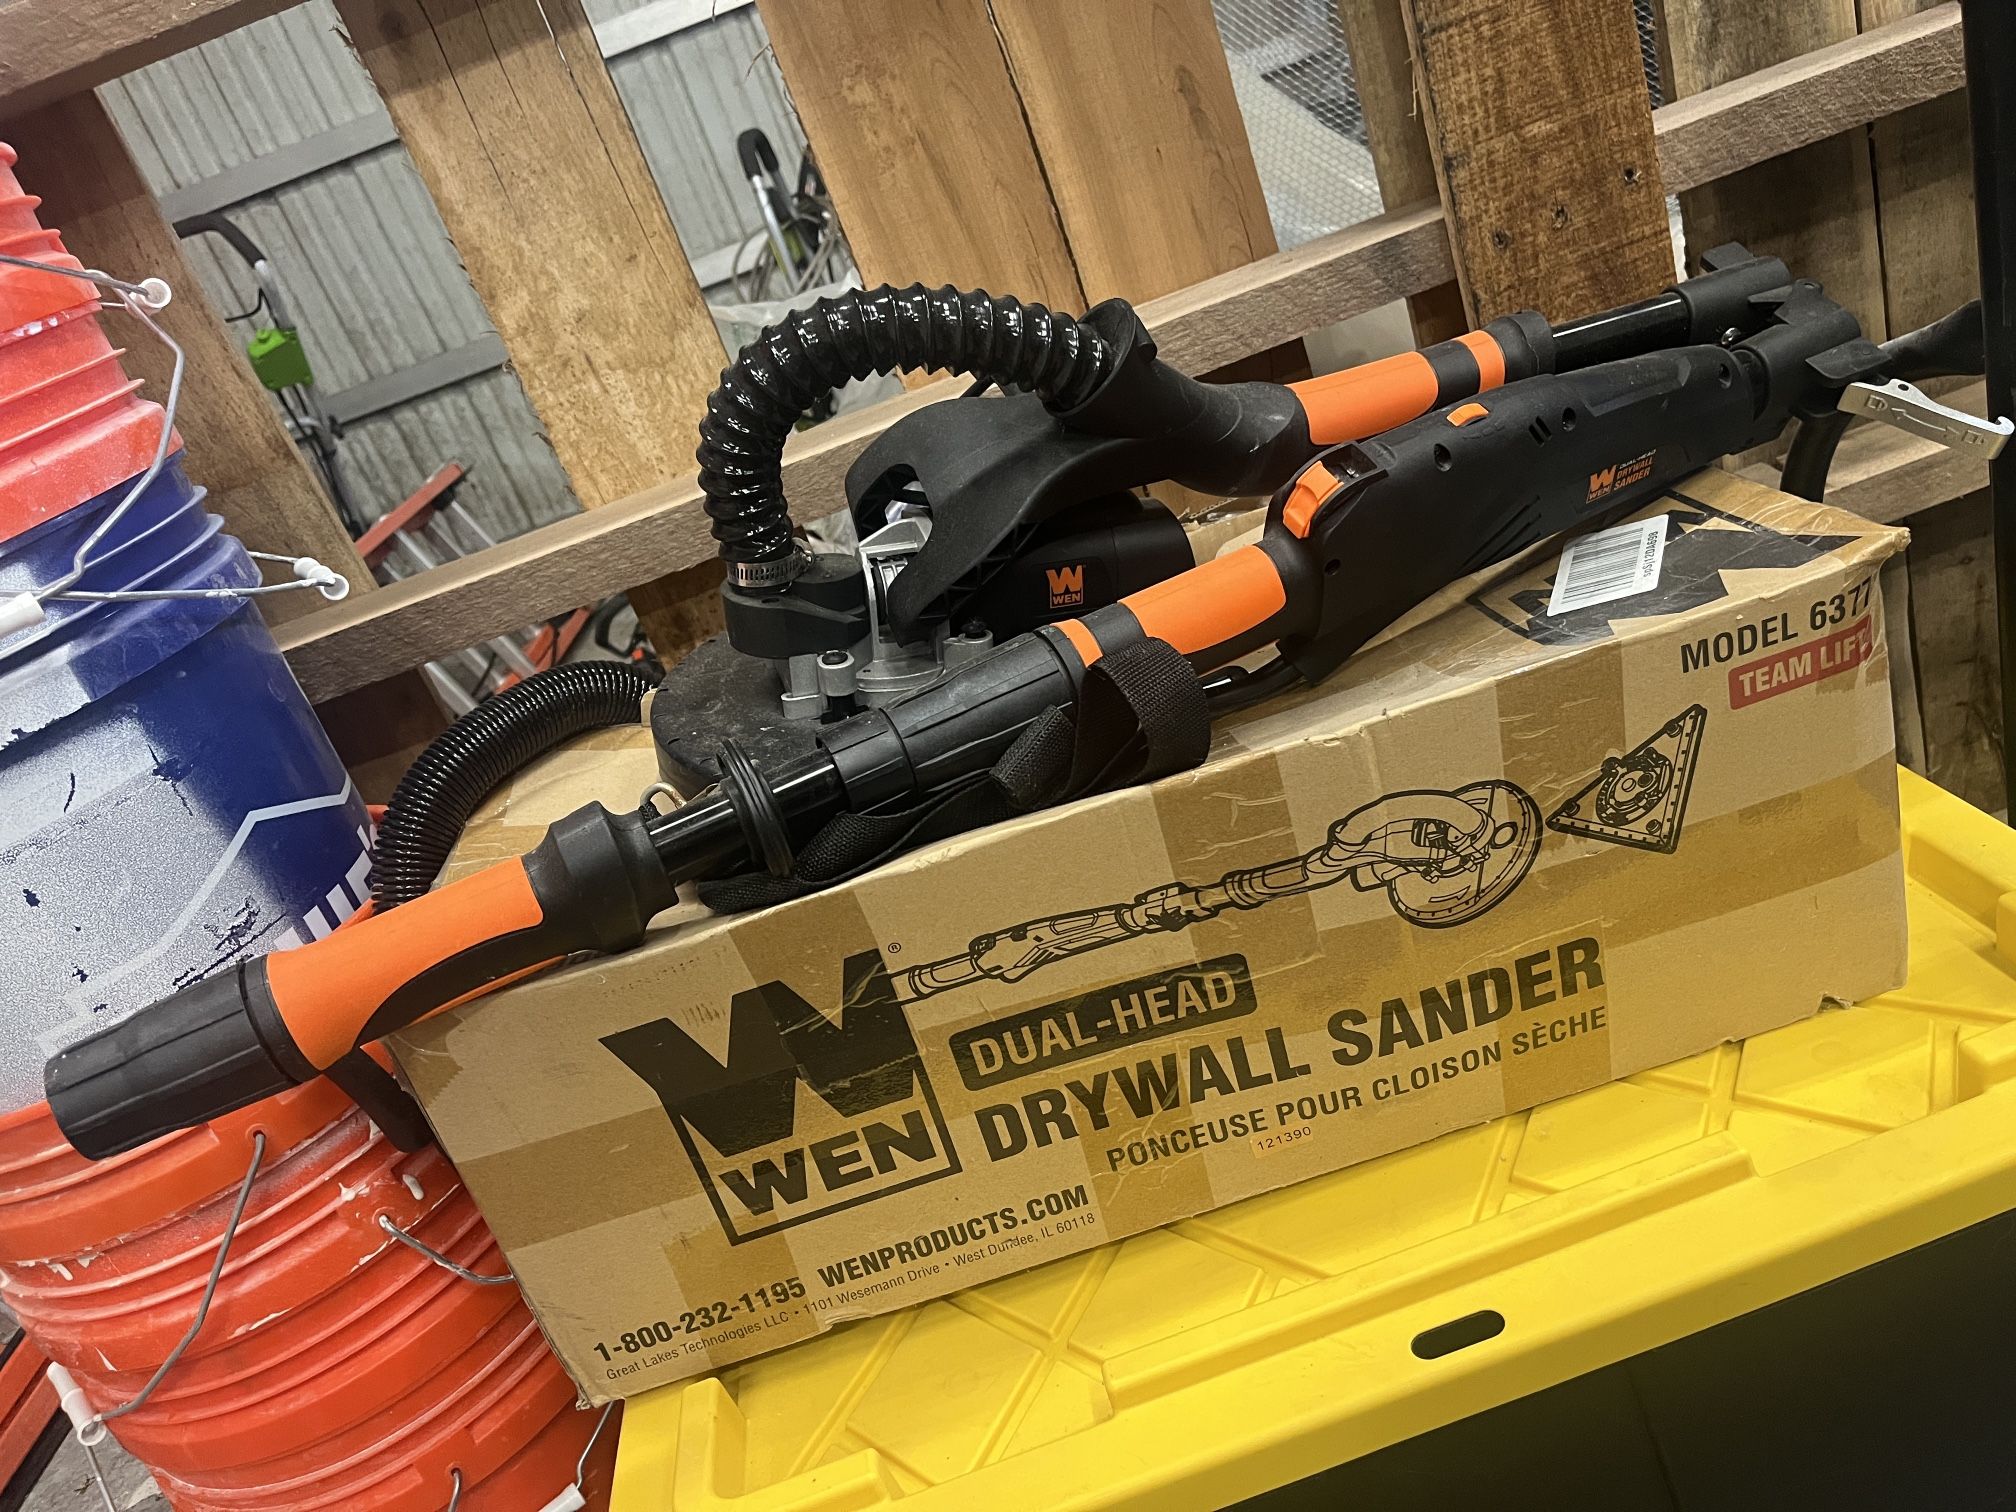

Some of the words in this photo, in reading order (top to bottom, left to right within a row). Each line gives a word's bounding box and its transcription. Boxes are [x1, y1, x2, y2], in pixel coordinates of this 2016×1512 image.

[1613, 466, 1651, 491] SANDER
[1616, 456, 1653, 480] DRYWALL
[1052, 592, 1081, 605] WEN
[1681, 612, 1798, 674] MODEL
[1810, 575, 1872, 631] 6377
[1738, 655, 1812, 697] TEAM
[1821, 627, 1870, 670] LIFT
[969, 970, 1236, 1077] DUAL-HEAD
[974, 1026, 1312, 1162] DRYWALL
[1327, 936, 1605, 1066] SANDER
[1106, 1108, 1268, 1172] PONCEUSE
[1275, 1086, 1363, 1126] POUR
[1372, 1040, 1502, 1101] CLOISON
[1512, 1005, 1607, 1056] SÈCHE
[1257, 1126, 1312, 1151] 121390
[718, 1109, 937, 1217] WEN
[593, 1276, 806, 1362] 1-800-232-1195
[817, 1184, 1089, 1289] WENPRODUCTS.COM
[606, 1360, 641, 1380] Great
[644, 1348, 680, 1368] Lakes
[680, 1321, 762, 1356] Technologies
[763, 1311, 790, 1329] LLC
[803, 1297, 834, 1315] 1101
[836, 1275, 905, 1305] Wesemann
[906, 1262, 941, 1282] Drive
[952, 1249, 985, 1268] West
[988, 1233, 1039, 1257] Dundee,
[1041, 1222, 1054, 1239] IL
[1056, 1212, 1096, 1234] 60118
